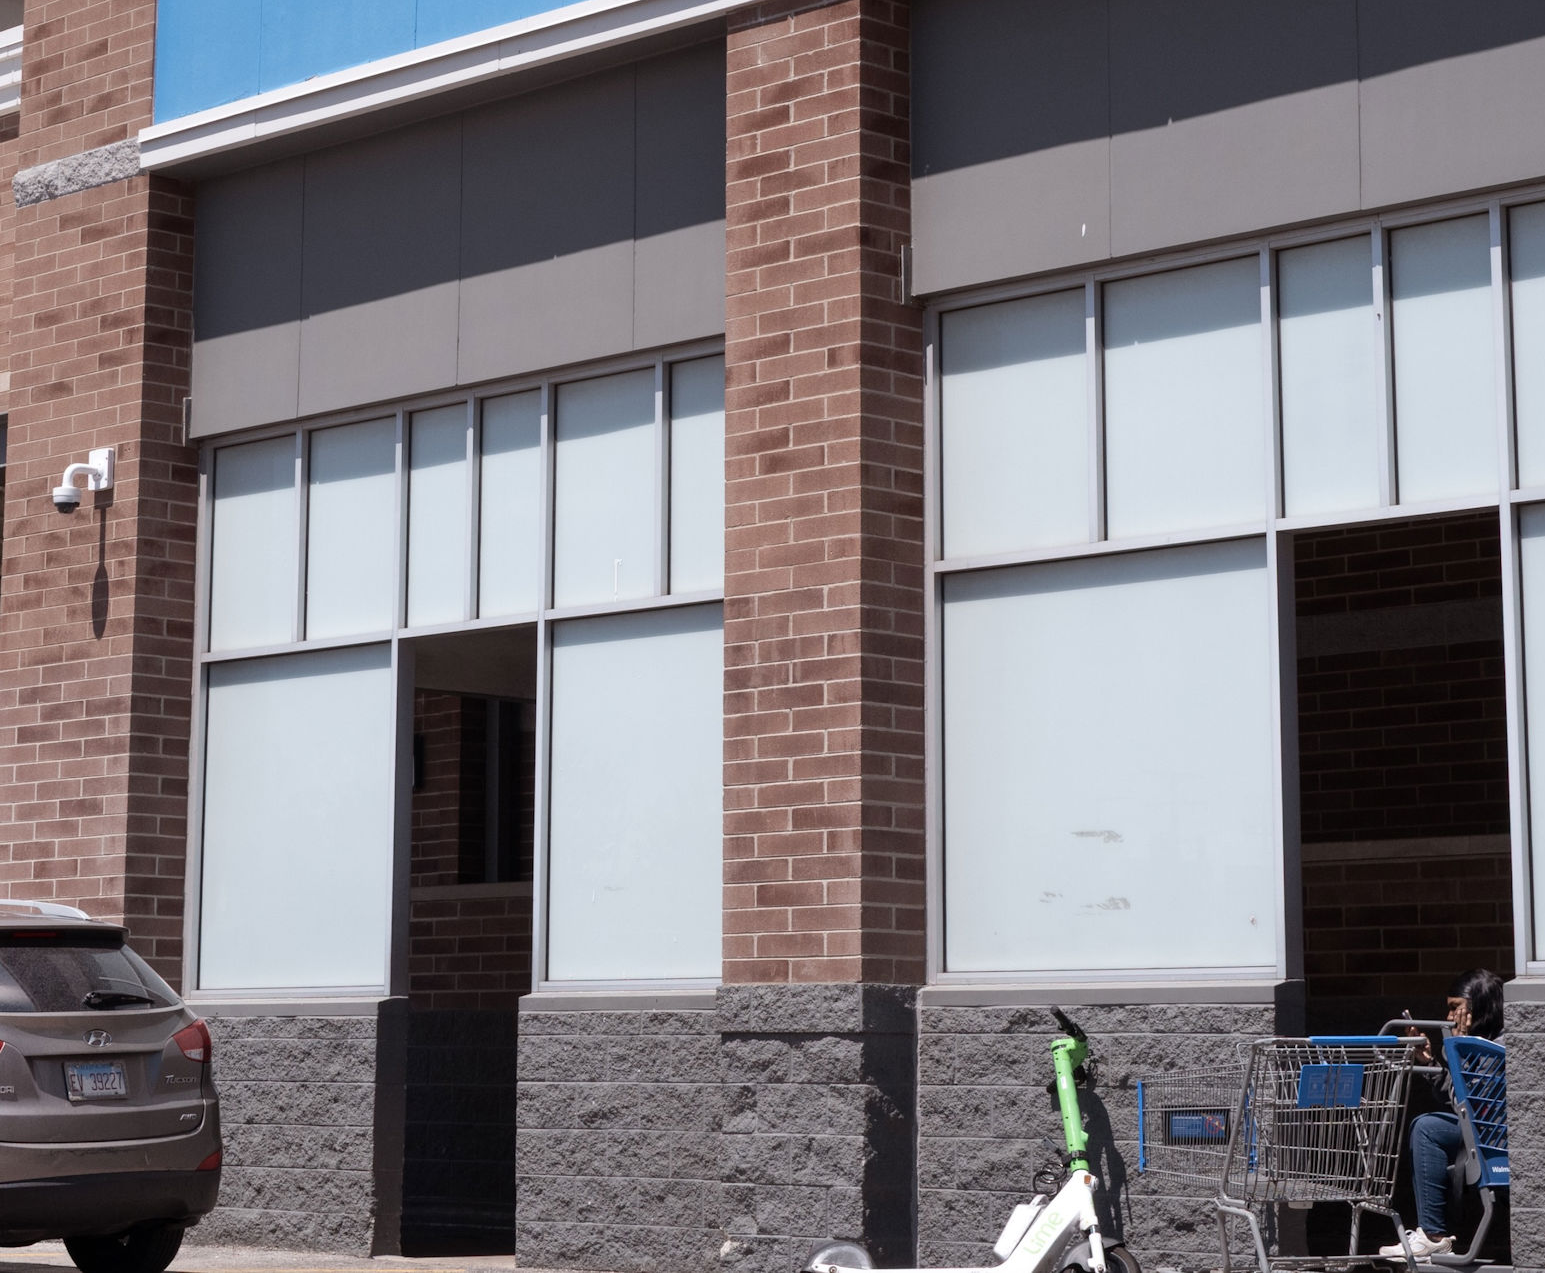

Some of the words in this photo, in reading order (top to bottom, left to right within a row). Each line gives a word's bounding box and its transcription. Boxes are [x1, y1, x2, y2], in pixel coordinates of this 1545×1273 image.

[69, 1073, 83, 1091] EV
[89, 1071, 122, 1090] 39227
[165, 1074, 197, 1084] Tucson
[1023, 1212, 1063, 1254] Lime
